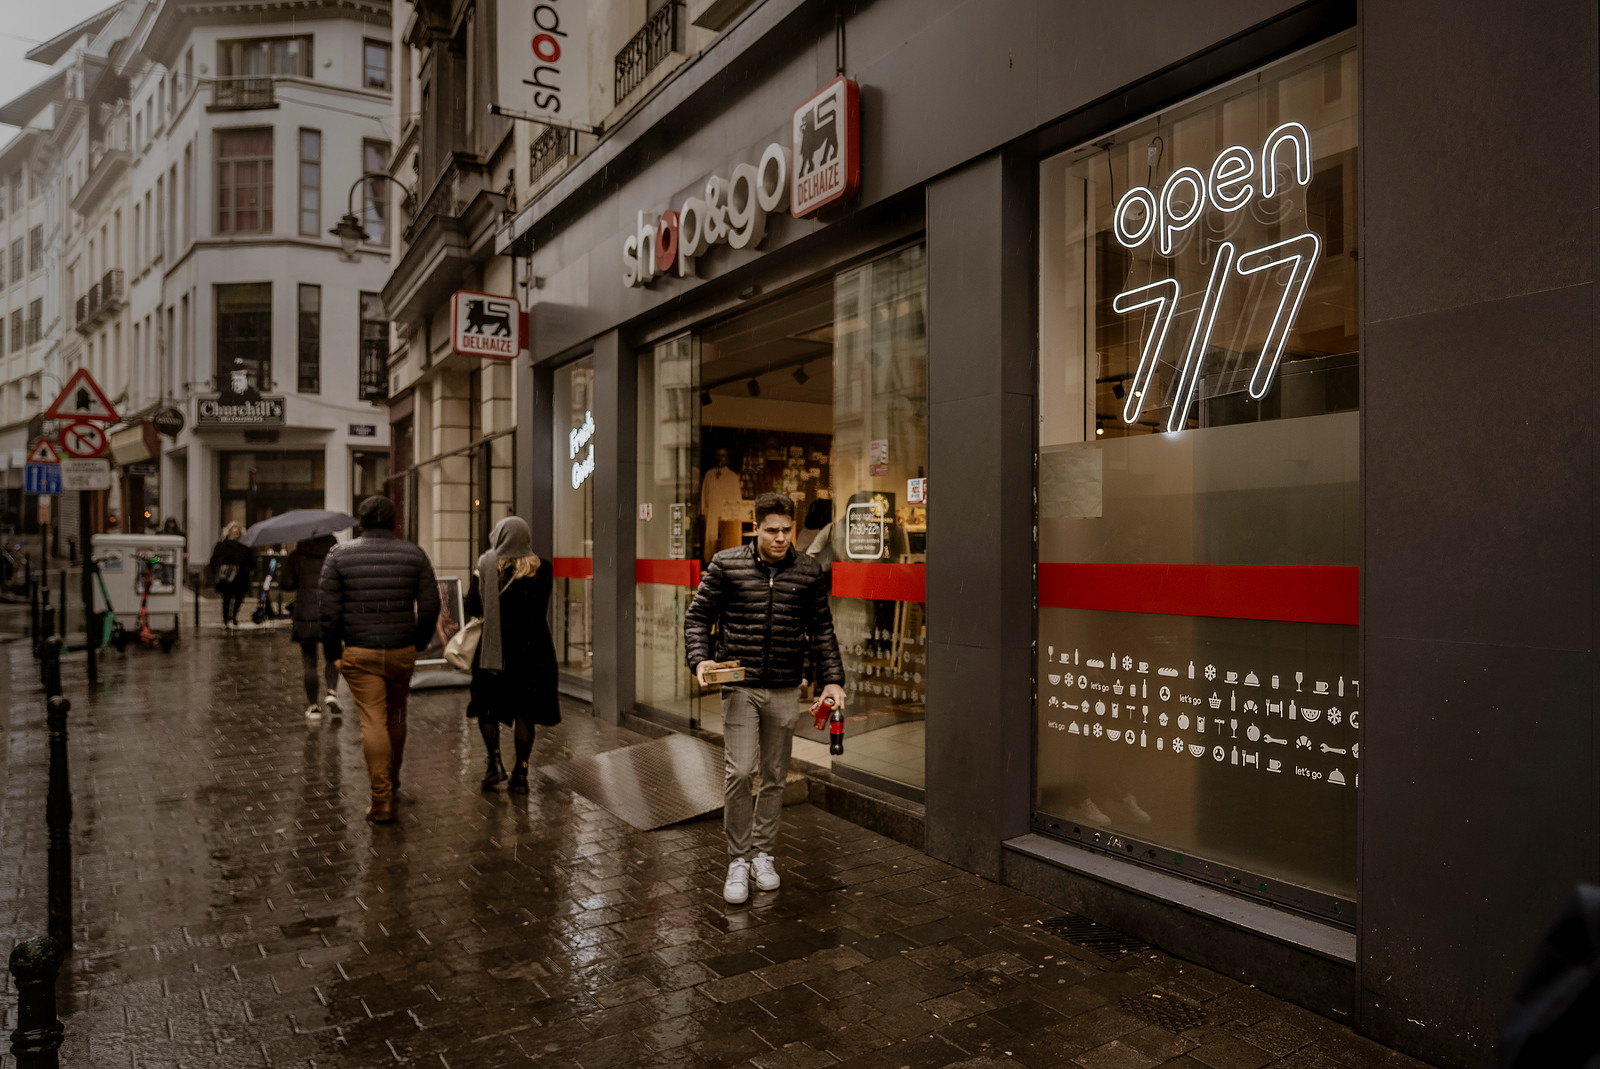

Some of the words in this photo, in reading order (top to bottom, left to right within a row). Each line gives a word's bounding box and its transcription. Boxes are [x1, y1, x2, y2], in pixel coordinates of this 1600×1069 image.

[523, 0, 568, 113] shop
[797, 162, 840, 206] DELHAIZE
[1114, 121, 1310, 254] open
[622, 143, 787, 288] shop&go
[1113, 233, 1319, 433] 7/7
[462, 335, 513, 353] DELHAIZE
[200, 400, 282, 417] Churchill's
[1090, 682, 1101, 691] let's
[1179, 694, 1192, 704] let's
[1192, 697, 1202, 706] go
[1047, 720, 1058, 729] let's
[1058, 723, 1065, 731] go
[1295, 766, 1311, 777] let's
[1311, 771, 1322, 780] go
